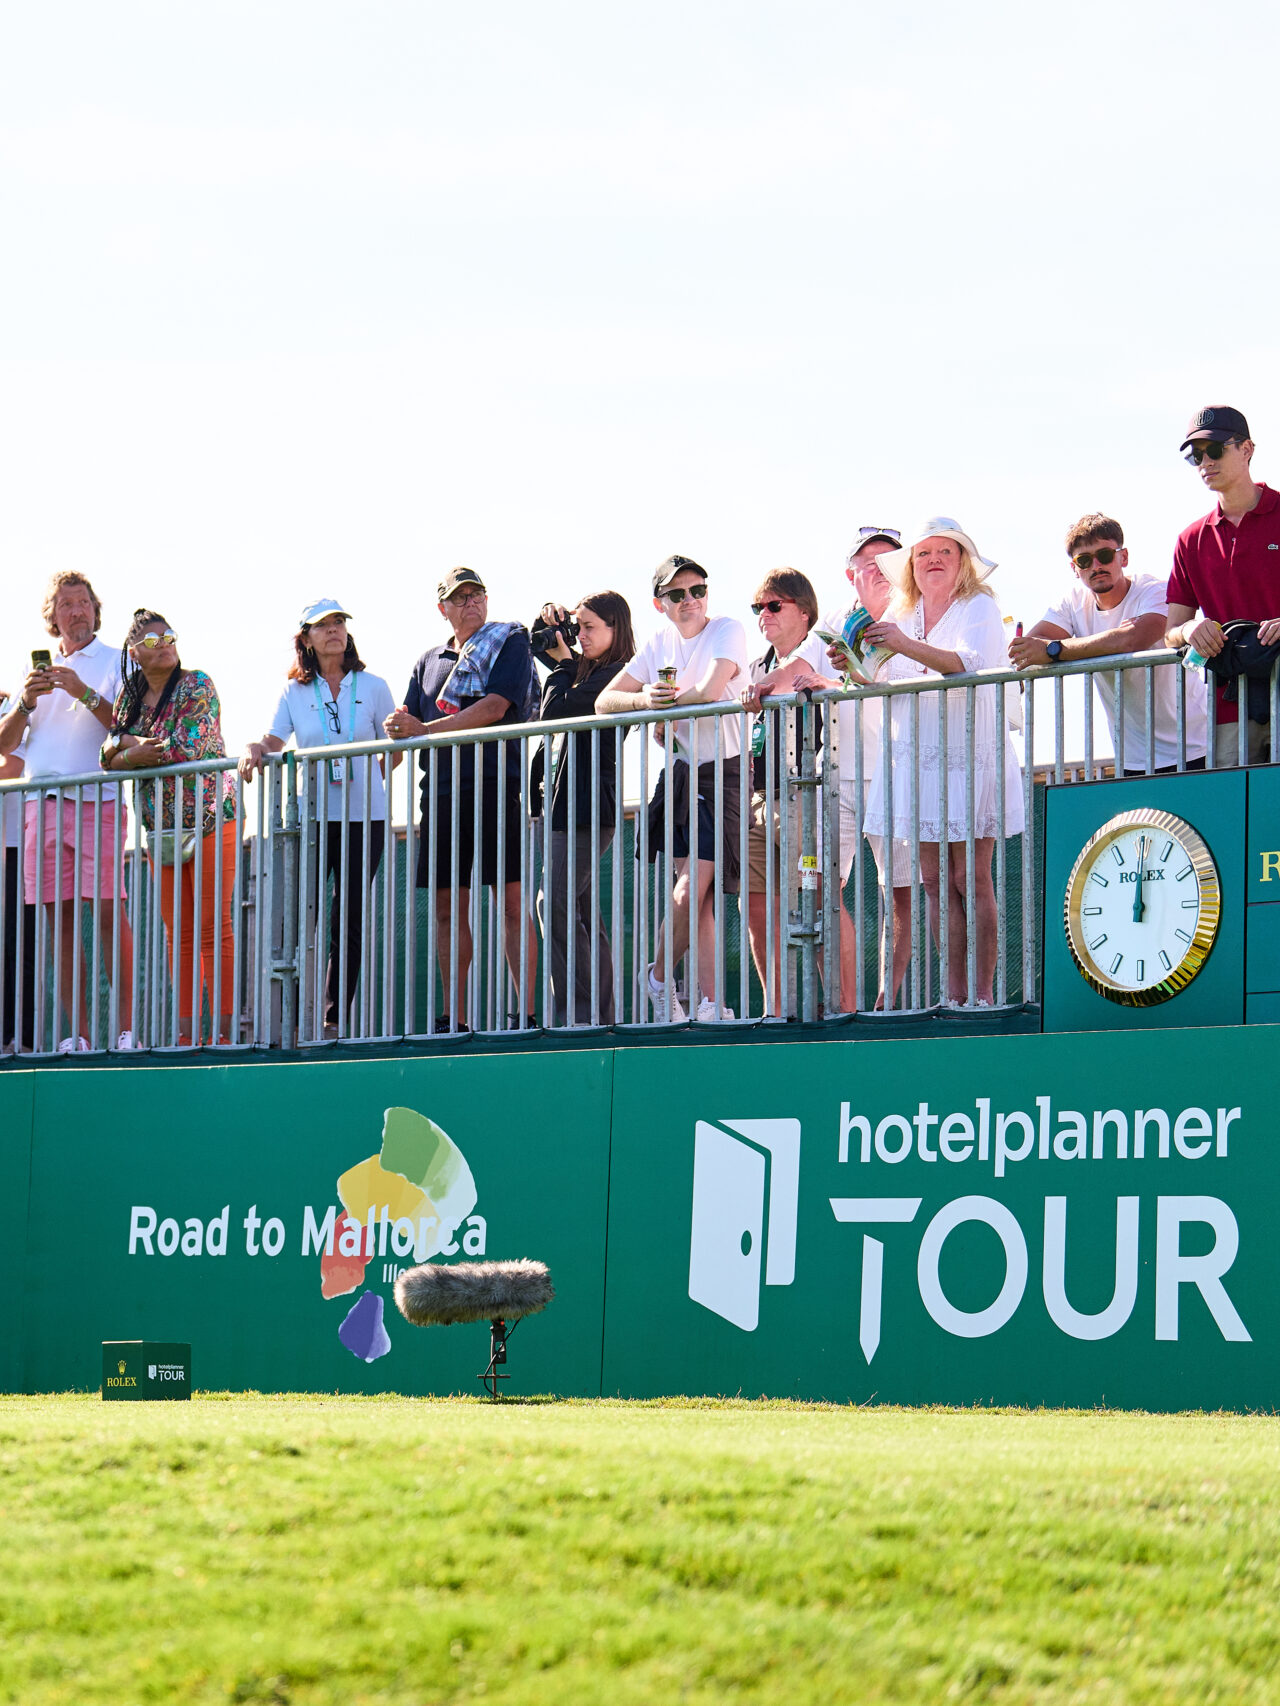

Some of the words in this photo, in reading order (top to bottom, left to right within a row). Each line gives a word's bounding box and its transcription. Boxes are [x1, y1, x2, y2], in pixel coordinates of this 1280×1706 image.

[1120, 869, 1166, 884] ROLEX
[838, 1095, 1241, 1177] hotelplanner
[128, 1204, 230, 1256] Road
[243, 1205, 286, 1256] to
[301, 1204, 488, 1258] Mallorca
[828, 1195, 1253, 1366] TOUR
[107, 1377, 137, 1387] ROLEX
[158, 1371, 184, 1382] TOUR
